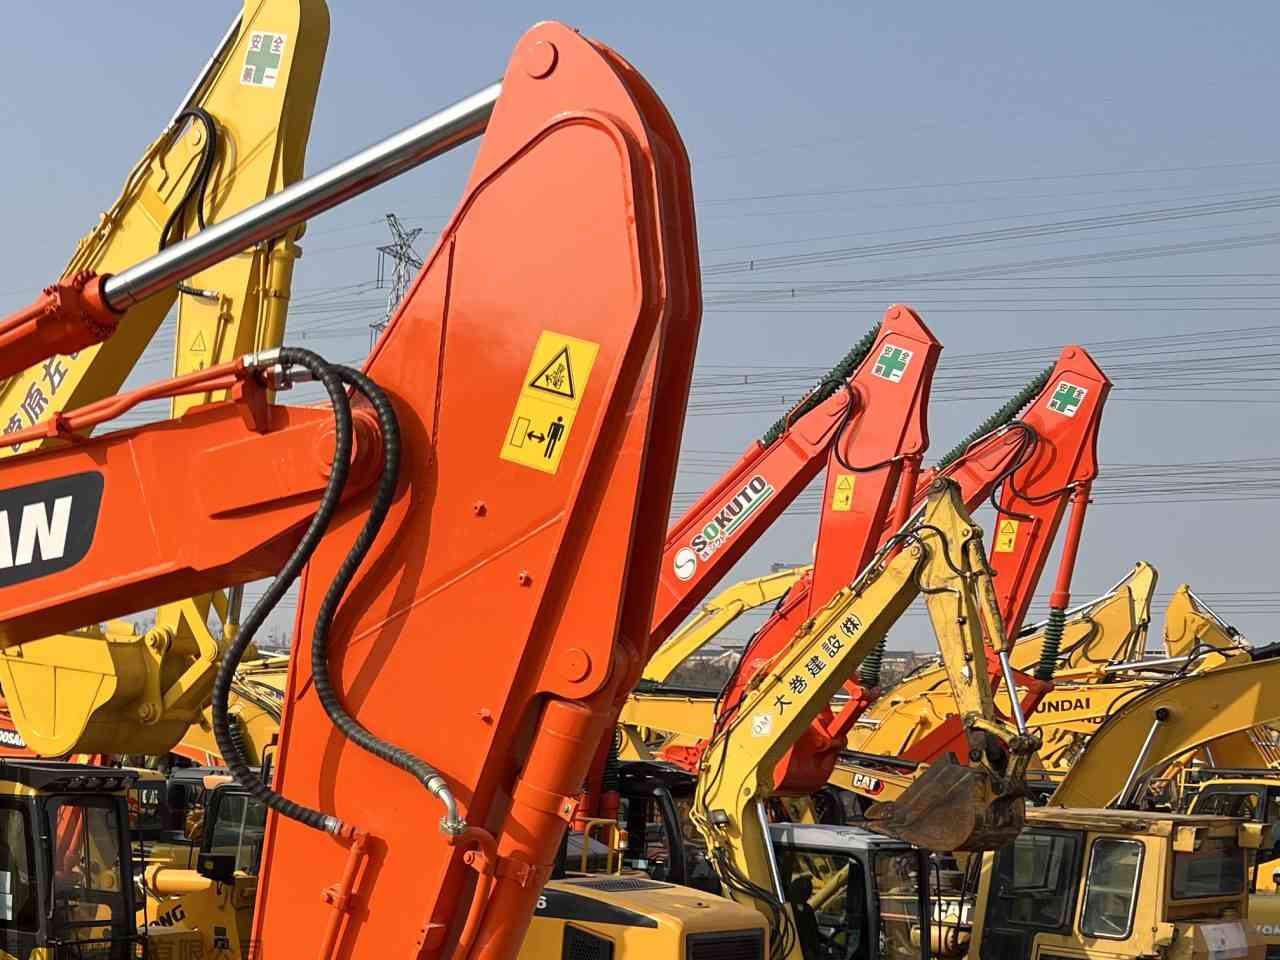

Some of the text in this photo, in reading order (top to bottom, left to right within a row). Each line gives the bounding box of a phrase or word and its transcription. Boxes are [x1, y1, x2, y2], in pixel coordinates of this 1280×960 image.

[3, 349, 80, 453] 菅原左
[691, 475, 768, 553] SOKUTO
[1034, 697, 1091, 714] UNDAI
[852, 772, 879, 791] CAT
